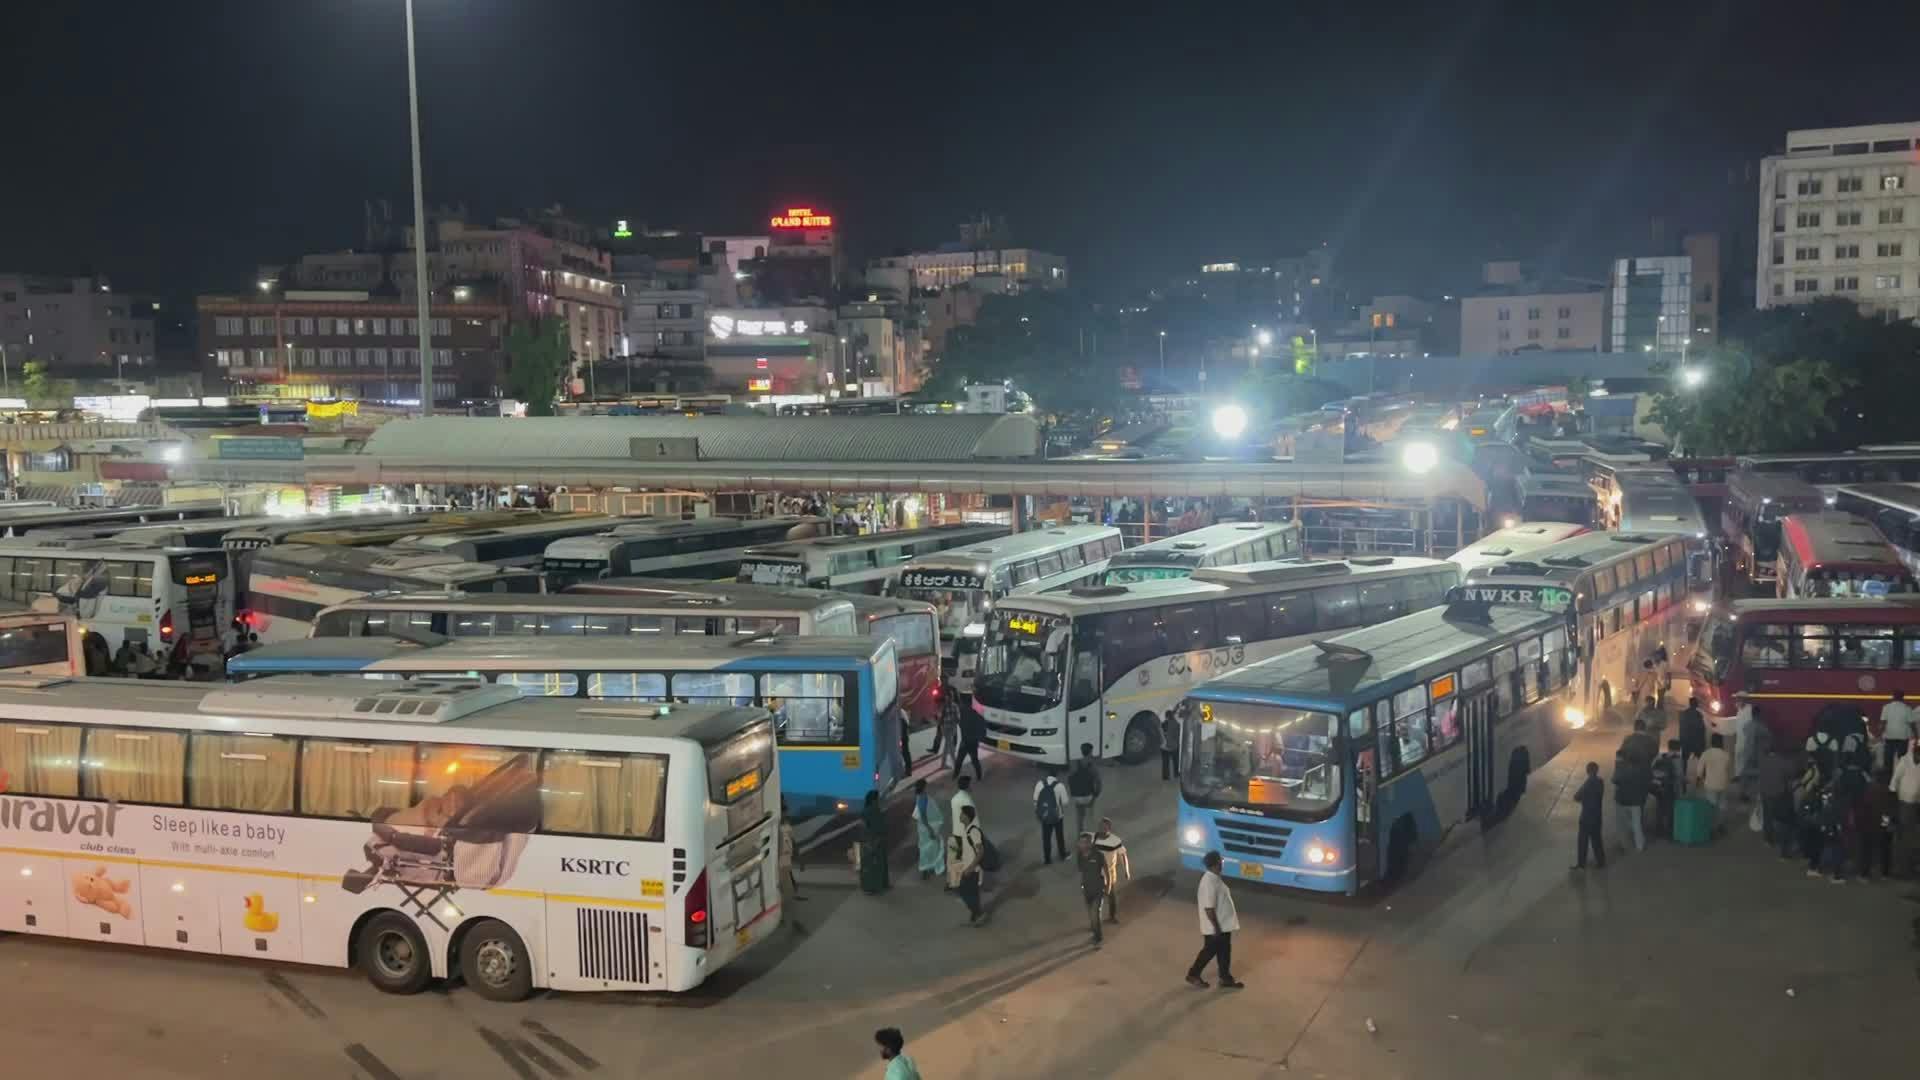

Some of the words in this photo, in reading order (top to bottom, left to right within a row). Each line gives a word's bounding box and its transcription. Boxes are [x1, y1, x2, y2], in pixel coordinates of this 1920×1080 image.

[152, 815, 197, 837] Sleep
[201, 818, 229, 836] like
[232, 824, 241, 837] a
[246, 823, 285, 845] baby
[80, 842, 104, 852] club
[107, 844, 136, 855] class
[560, 857, 631, 877] KSRTC
